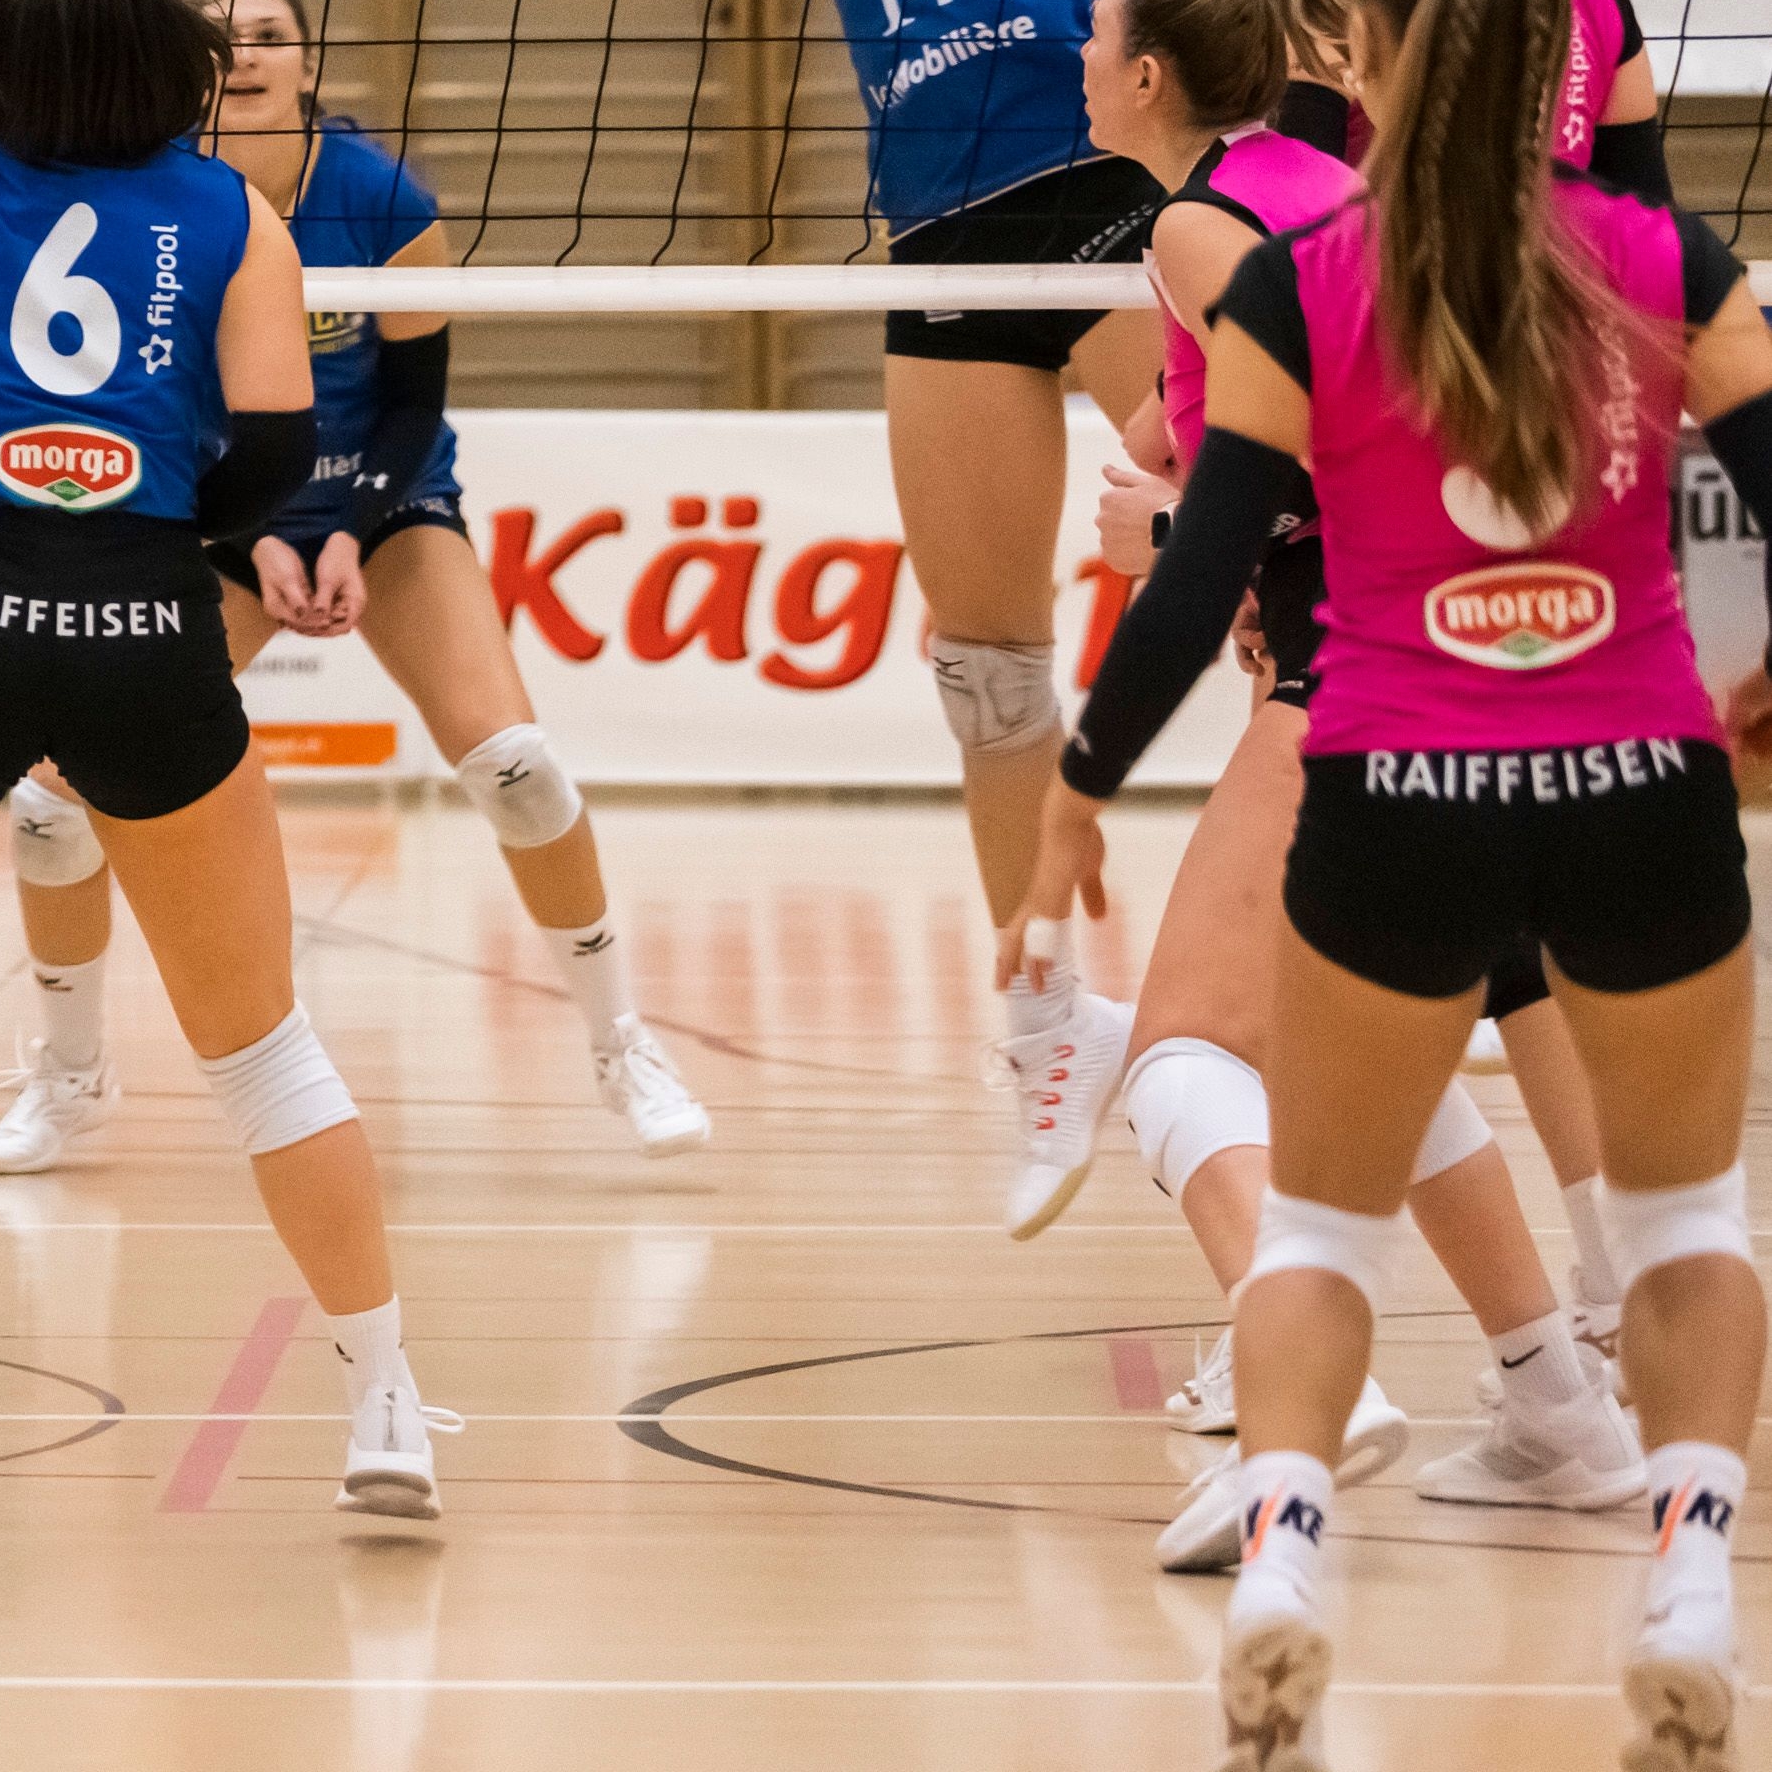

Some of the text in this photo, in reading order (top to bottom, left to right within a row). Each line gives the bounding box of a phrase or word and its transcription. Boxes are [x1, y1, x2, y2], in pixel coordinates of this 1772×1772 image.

[10, 202, 121, 396] 6
[145, 223, 184, 328] fitpool
[9, 444, 125, 483] morga
[491, 495, 905, 692] Käg
[1444, 583, 1596, 632] morga
[1365, 736, 1687, 805] RAIFFEISEN
